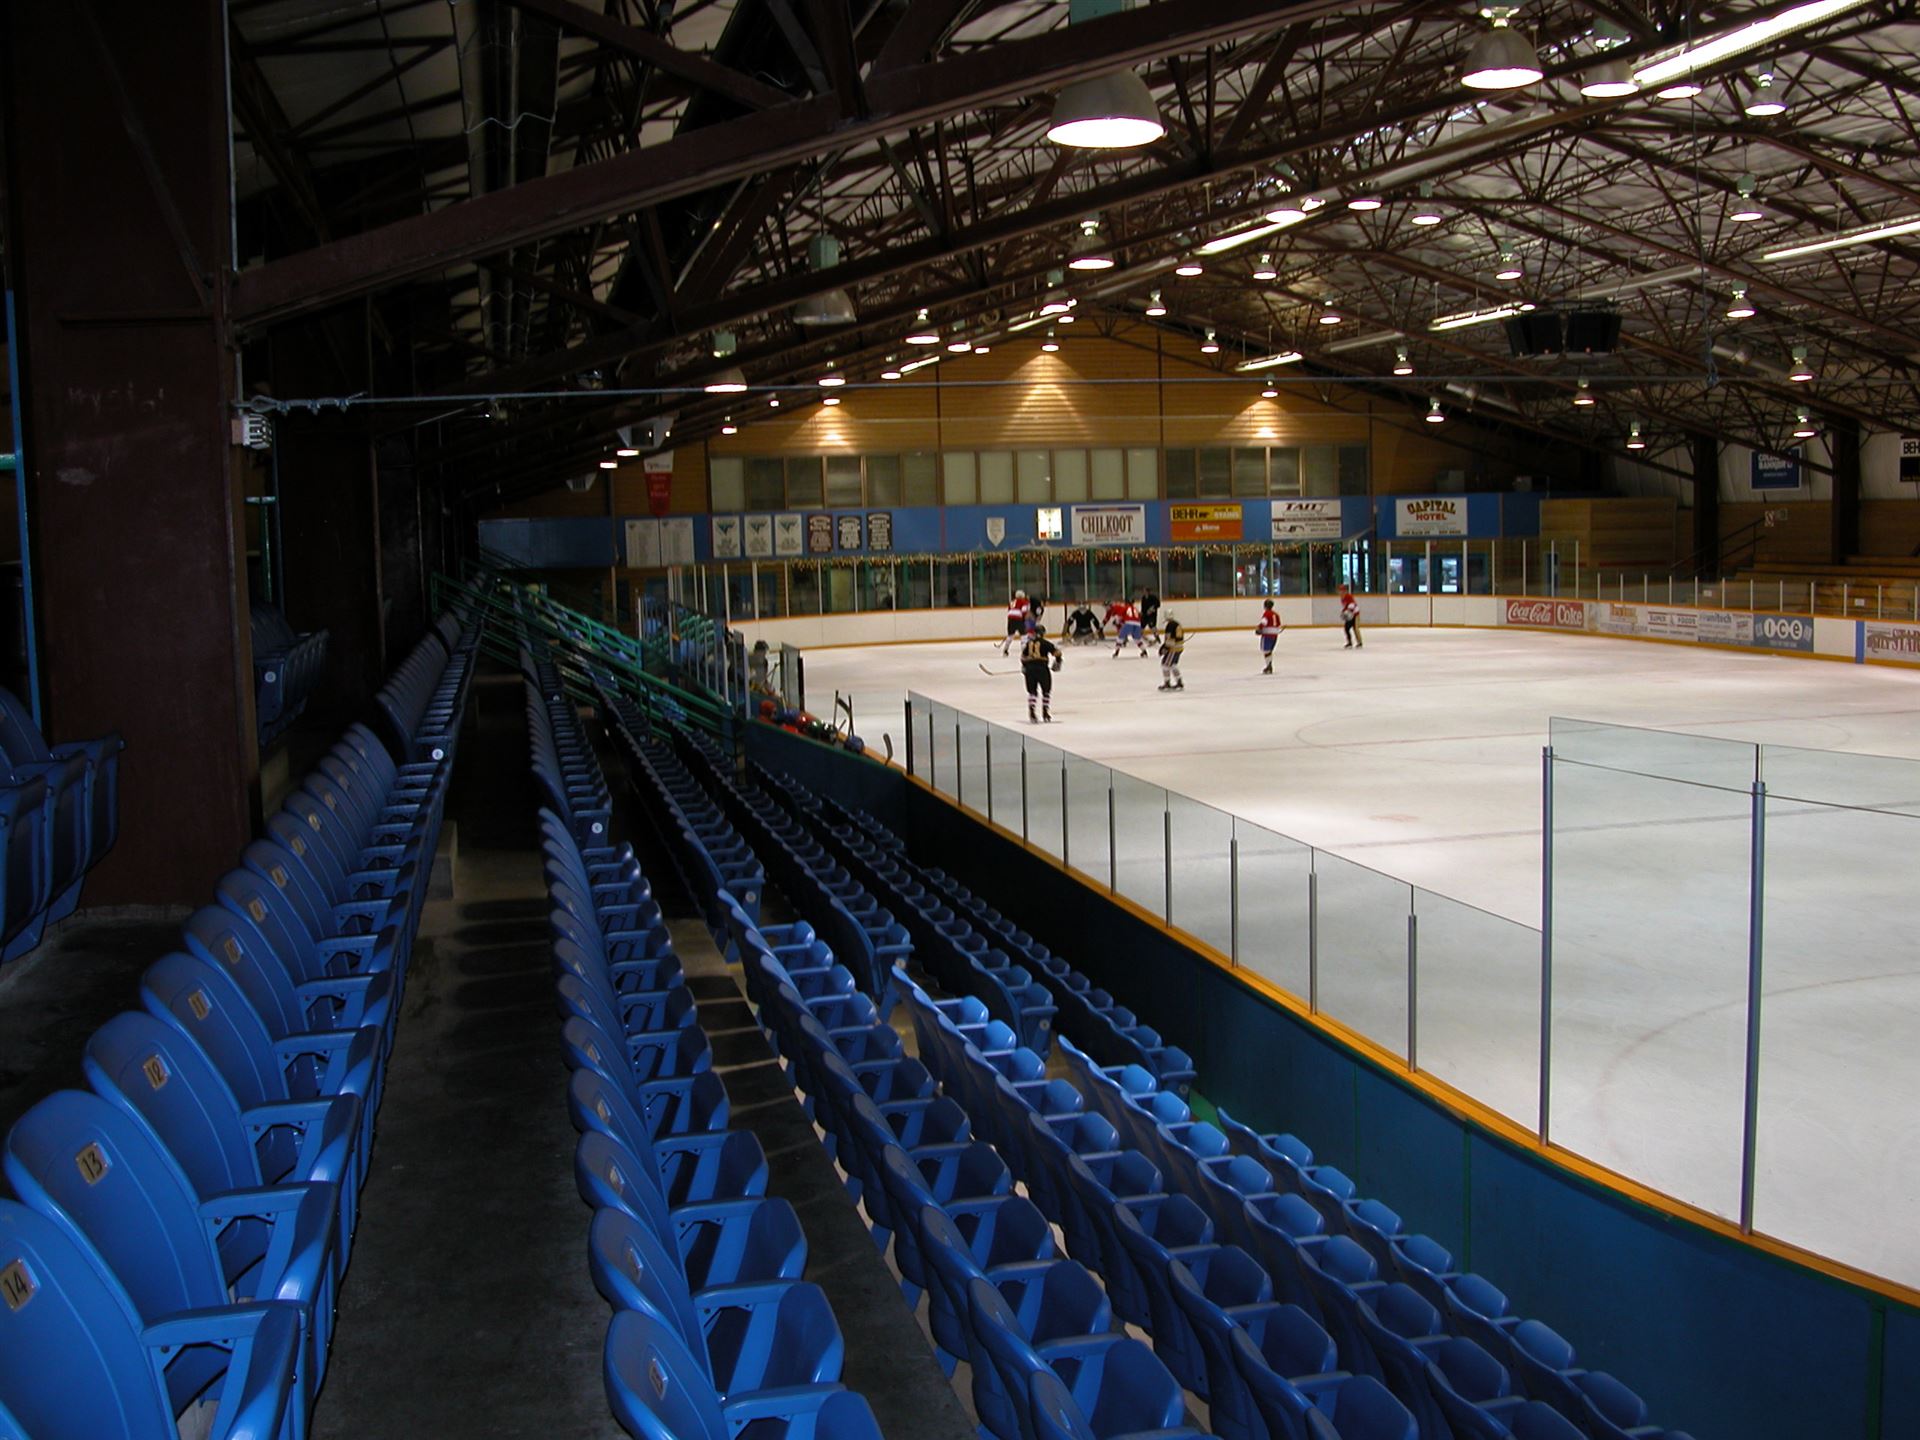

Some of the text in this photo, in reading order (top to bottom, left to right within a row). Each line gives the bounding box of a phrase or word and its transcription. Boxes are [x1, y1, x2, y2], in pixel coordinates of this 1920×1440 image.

[1903, 441, 1920, 454] BEH
[1172, 508, 1199, 519] BEHR
[1407, 500, 1456, 515] CAPITAL
[1081, 514, 1133, 534] CHILKOOT
[1416, 513, 1447, 521] HOTEL
[1557, 604, 1583, 625] Coke
[81, 1152, 104, 1181] 13
[4, 1271, 29, 1300] 14
